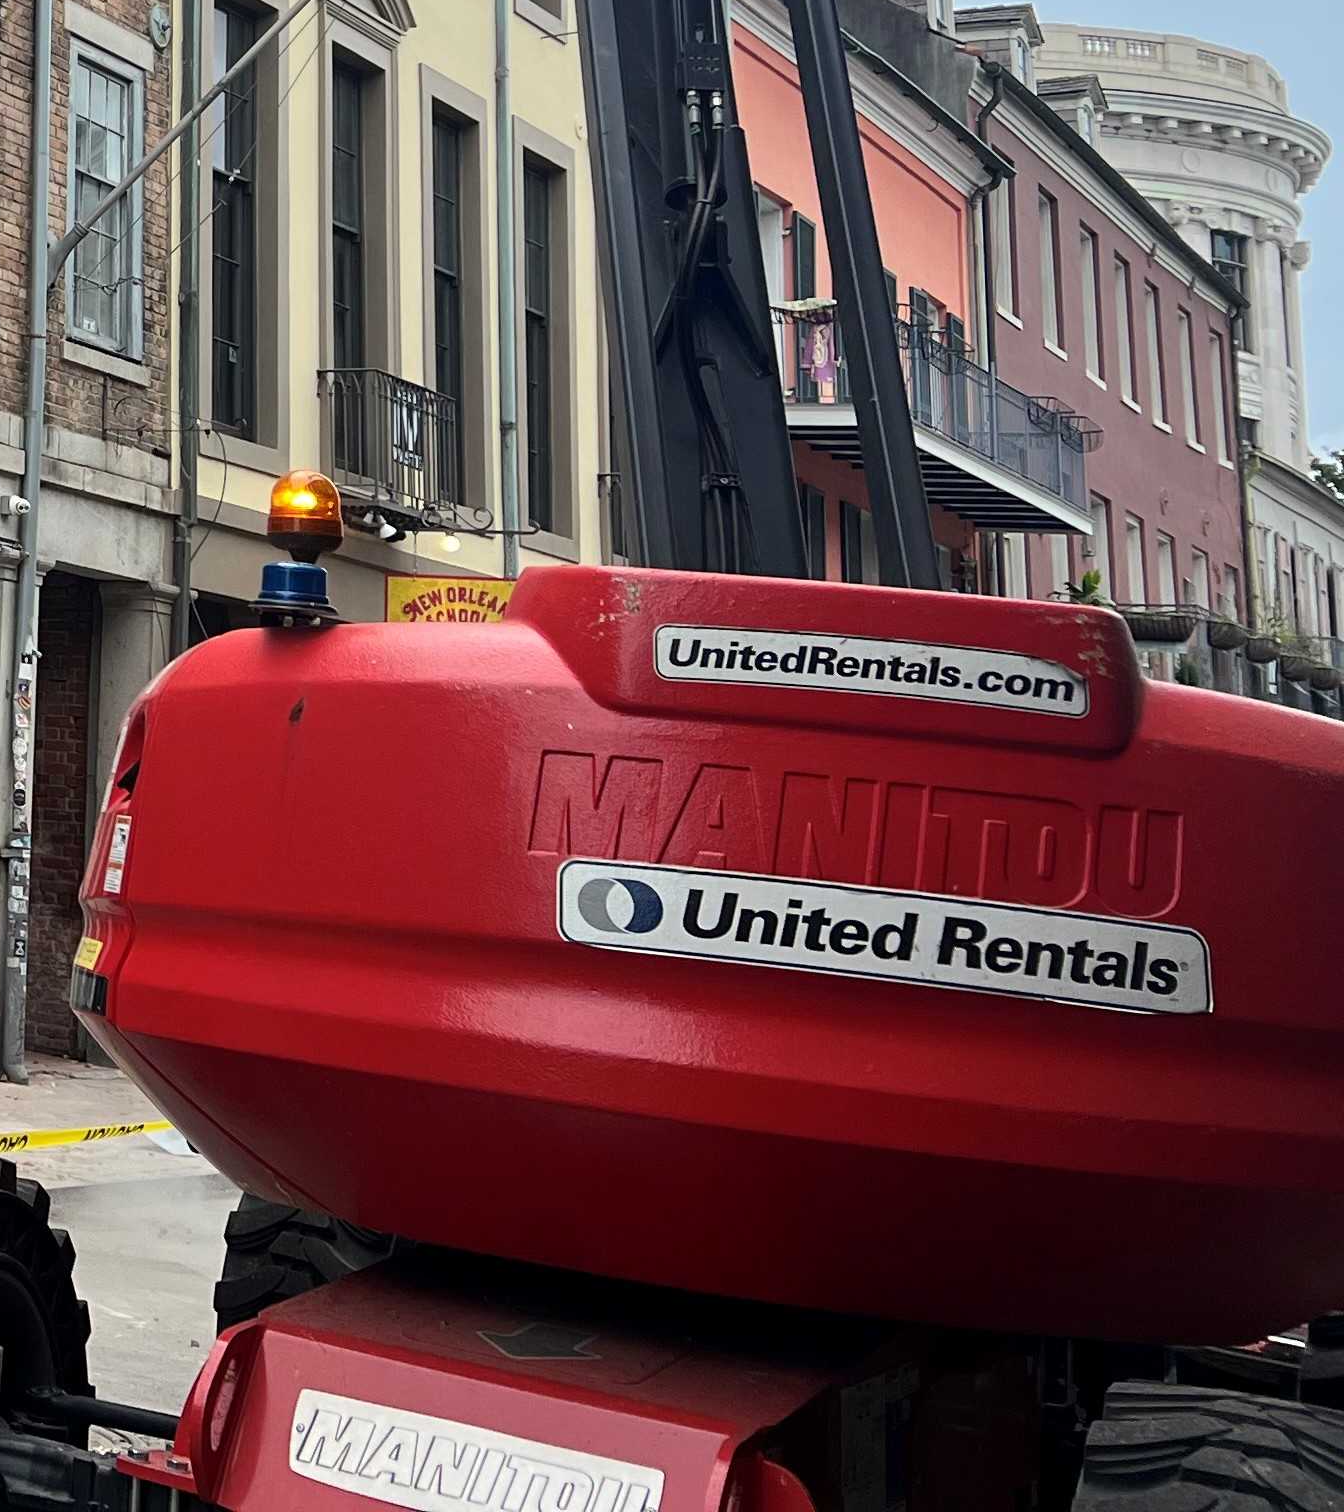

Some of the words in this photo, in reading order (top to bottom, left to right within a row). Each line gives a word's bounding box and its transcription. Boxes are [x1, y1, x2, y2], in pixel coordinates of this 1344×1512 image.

[402, 589, 442, 622] NEW
[668, 638, 1075, 702] UnitedRentals.com
[527, 749, 1184, 919] MANITOU
[682, 889, 919, 960] United
[937, 916, 1180, 996] Rentals
